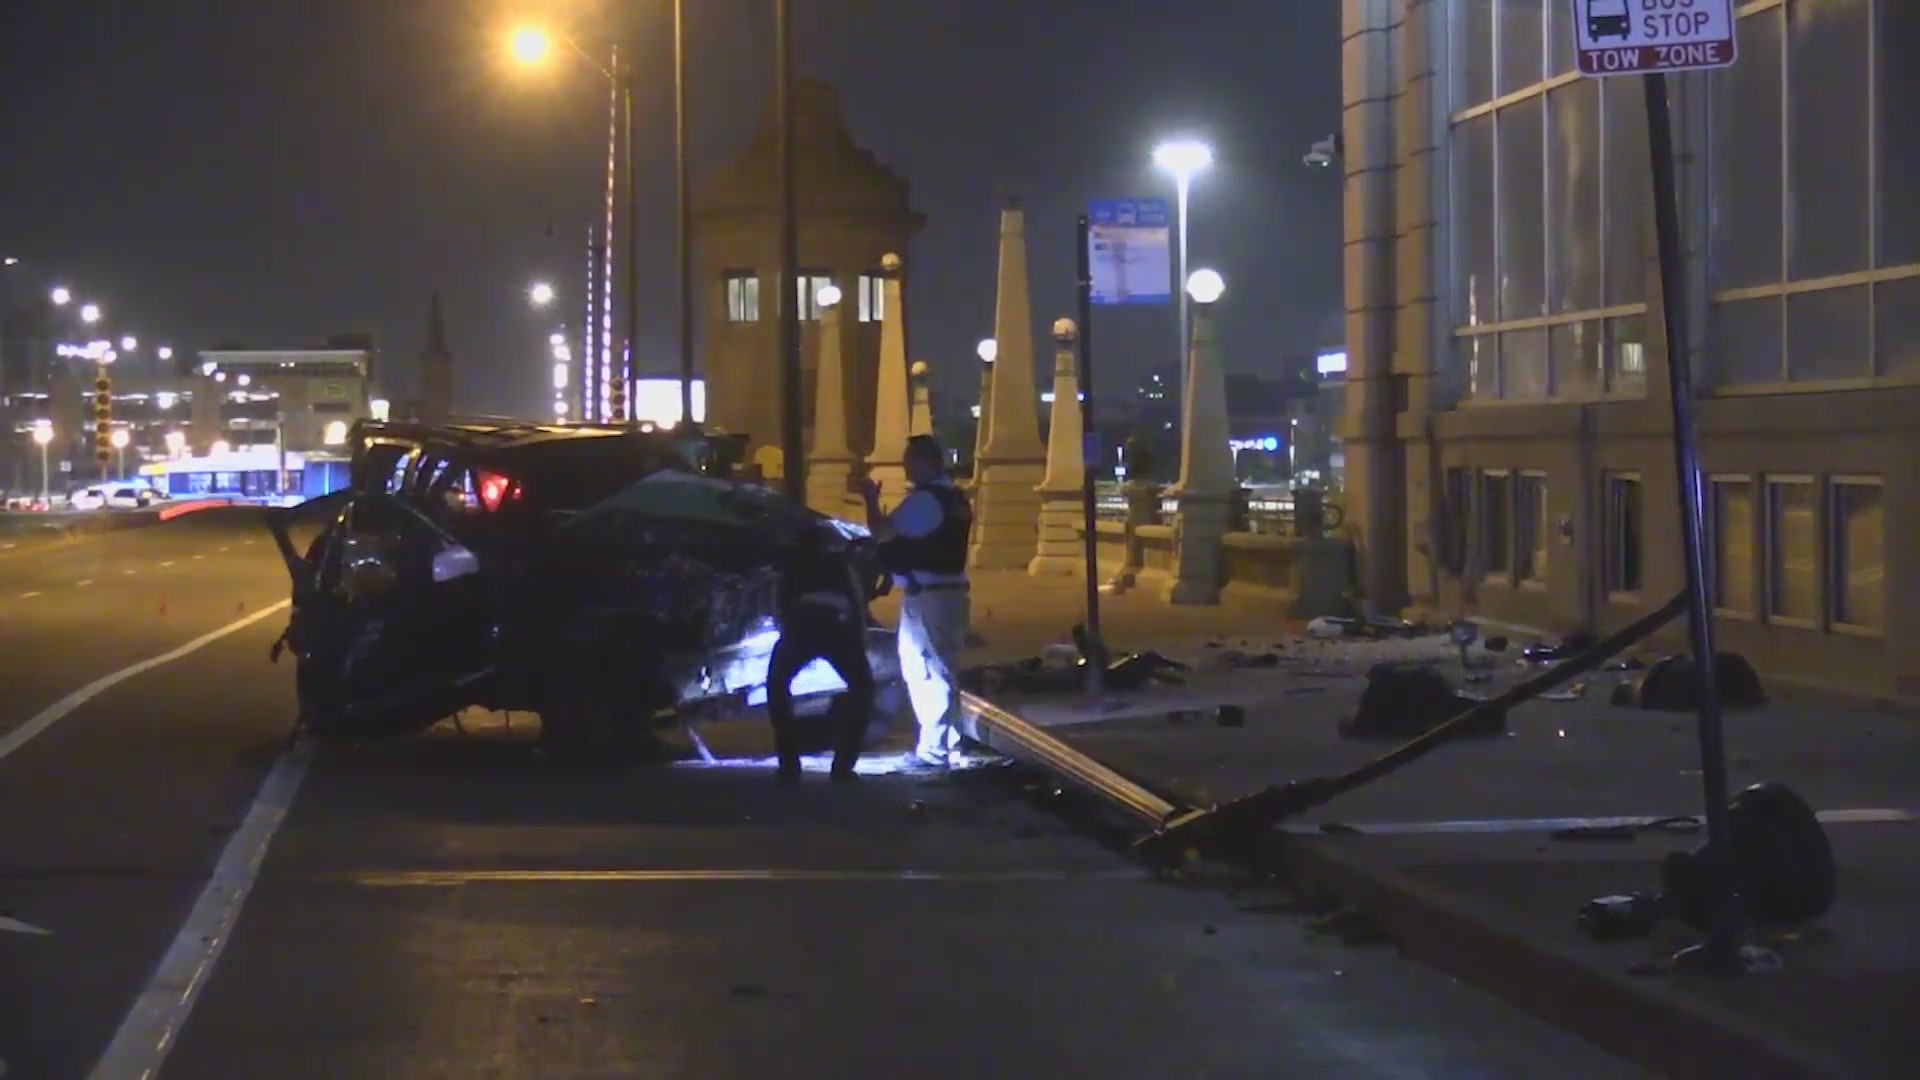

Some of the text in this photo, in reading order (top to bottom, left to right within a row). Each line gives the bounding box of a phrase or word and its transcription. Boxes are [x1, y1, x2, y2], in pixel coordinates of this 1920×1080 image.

[1643, 12, 1709, 38] STOP
[1588, 43, 1721, 72] TOW ZONE
